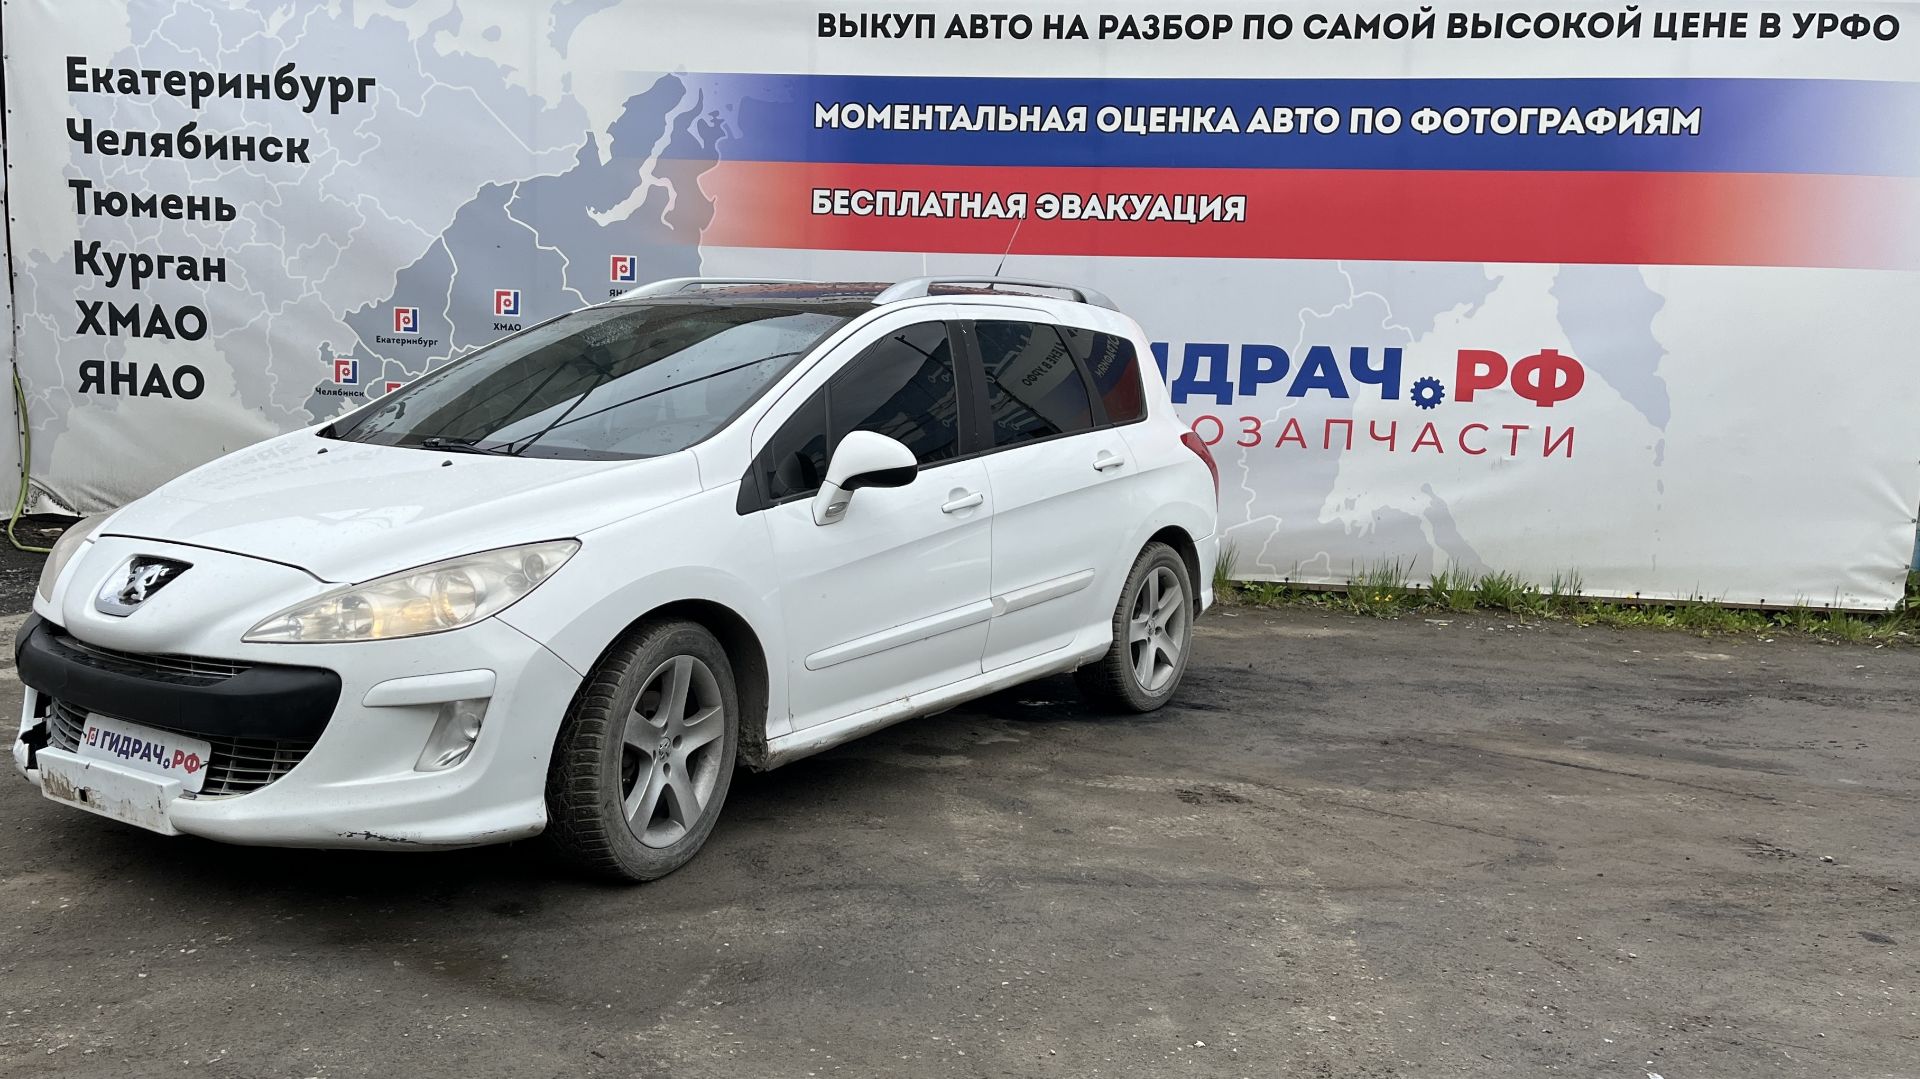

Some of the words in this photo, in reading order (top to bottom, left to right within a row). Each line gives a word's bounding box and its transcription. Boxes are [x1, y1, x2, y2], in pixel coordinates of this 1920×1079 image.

[818, 12, 936, 39] ВЫКУП
[944, 13, 1033, 40] АВТО
[1043, 14, 1090, 40] НА
[1098, 14, 1233, 40] РАЗБОР
[1242, 13, 1293, 40] ПО
[1303, 5, 1436, 40] САМОЙ
[1446, 5, 1642, 39] ВЫСОКОЙ
[1653, 12, 1748, 41] ЦЕНЕ
[1759, 12, 1781, 39] В
[1792, 12, 1900, 41] УРФО
[66, 56, 376, 115] Екатеринбург
[814, 102, 1087, 133] МОМЕНТАЛЬНАЯ
[1096, 105, 1240, 136] ОЦЕНКА
[1246, 106, 1340, 135] АВТО
[1349, 106, 1402, 135] ПО
[1410, 106, 1702, 135] ФОТОГРАФИЯМ
[66, 117, 310, 164] Челябинск
[68, 179, 237, 222] Тюмень
[811, 188, 1028, 220] БЕСПЛАТНАЯ
[1035, 192, 1247, 223] ЭВАКУАЦИЯ
[73, 239, 226, 290] Курган
[609, 289, 628, 297] ЯН
[75, 299, 208, 342] ХМАО
[493, 323, 522, 331] ХМАО
[375, 335, 439, 347] Екатеринбург
[78, 359, 205, 400] ЯНАО
[315, 387, 364, 397] Челябинск
[1190, 414, 1575, 459] ОЗАПЧАСТИ
